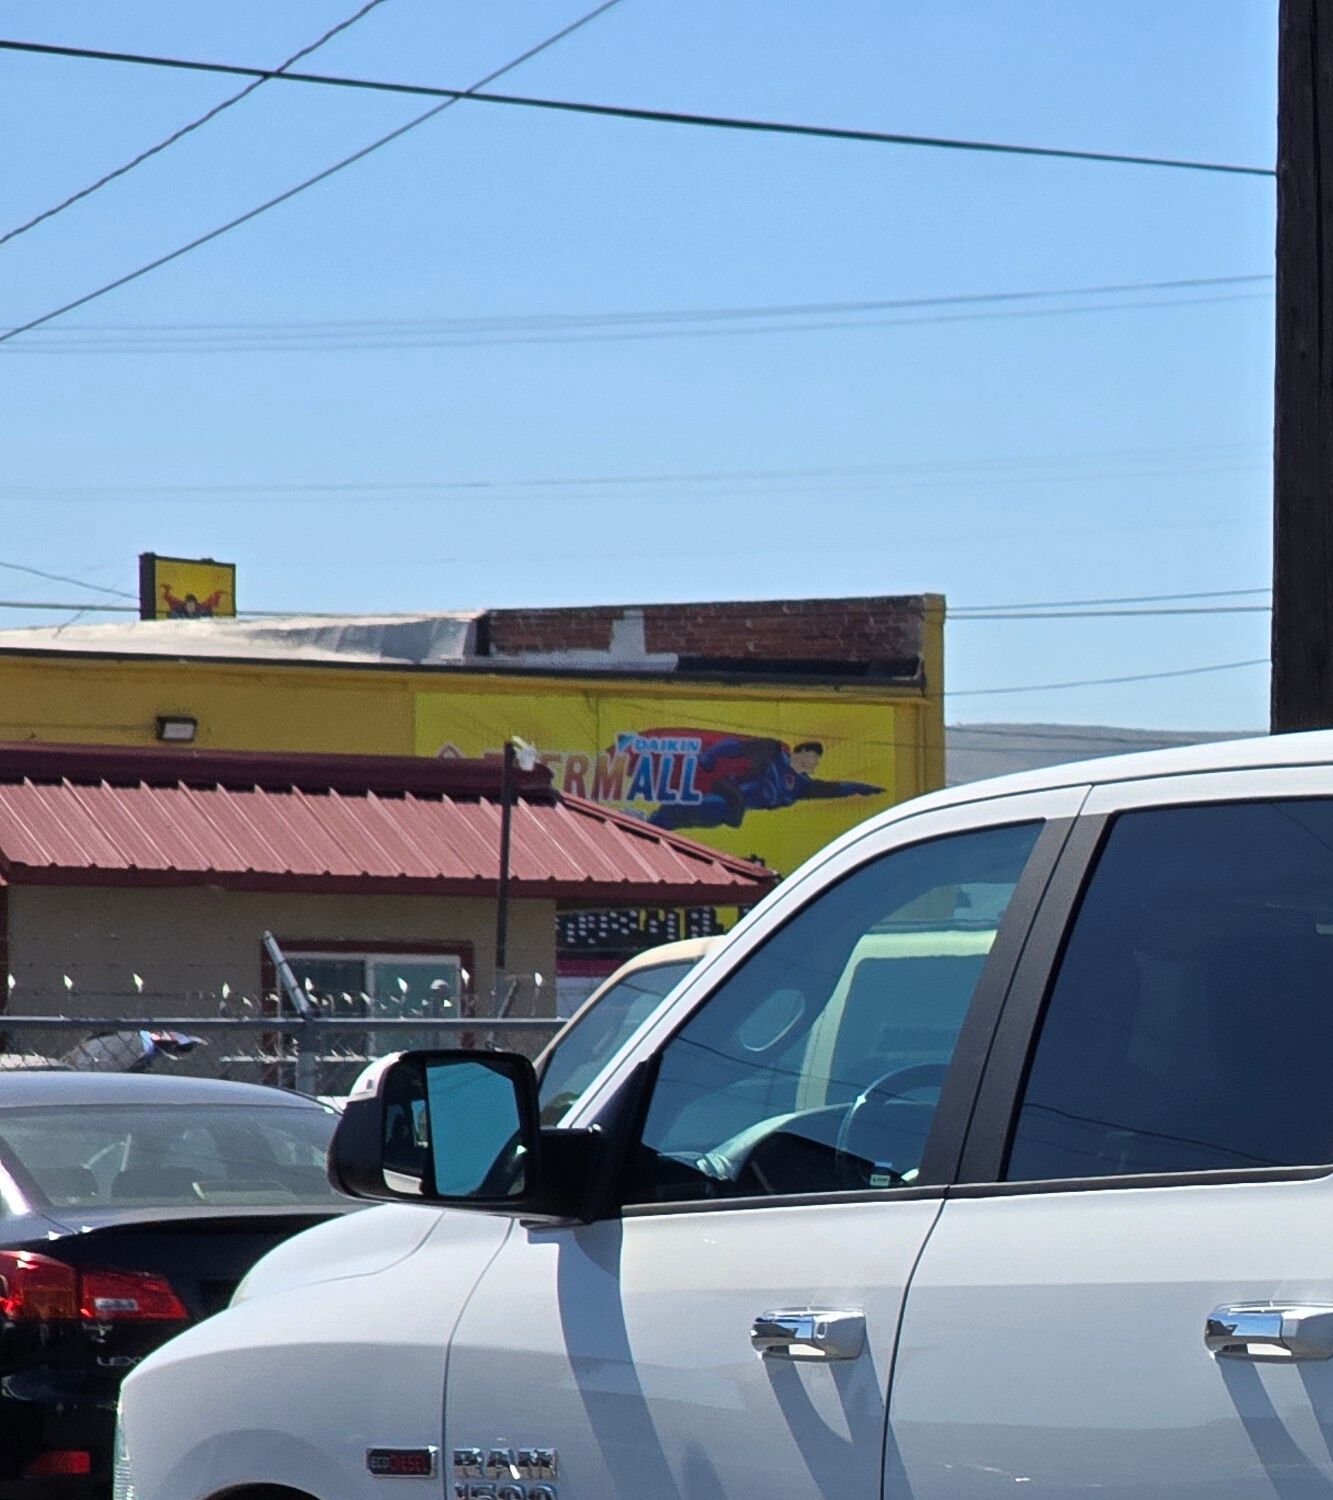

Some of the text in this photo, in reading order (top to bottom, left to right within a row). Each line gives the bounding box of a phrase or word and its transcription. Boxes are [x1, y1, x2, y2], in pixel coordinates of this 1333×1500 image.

[634, 738, 700, 752] DAIKIN
[482, 752, 702, 803] RMALL
[96, 1355, 143, 1367] LEX
[453, 1448, 558, 1480] RAM
